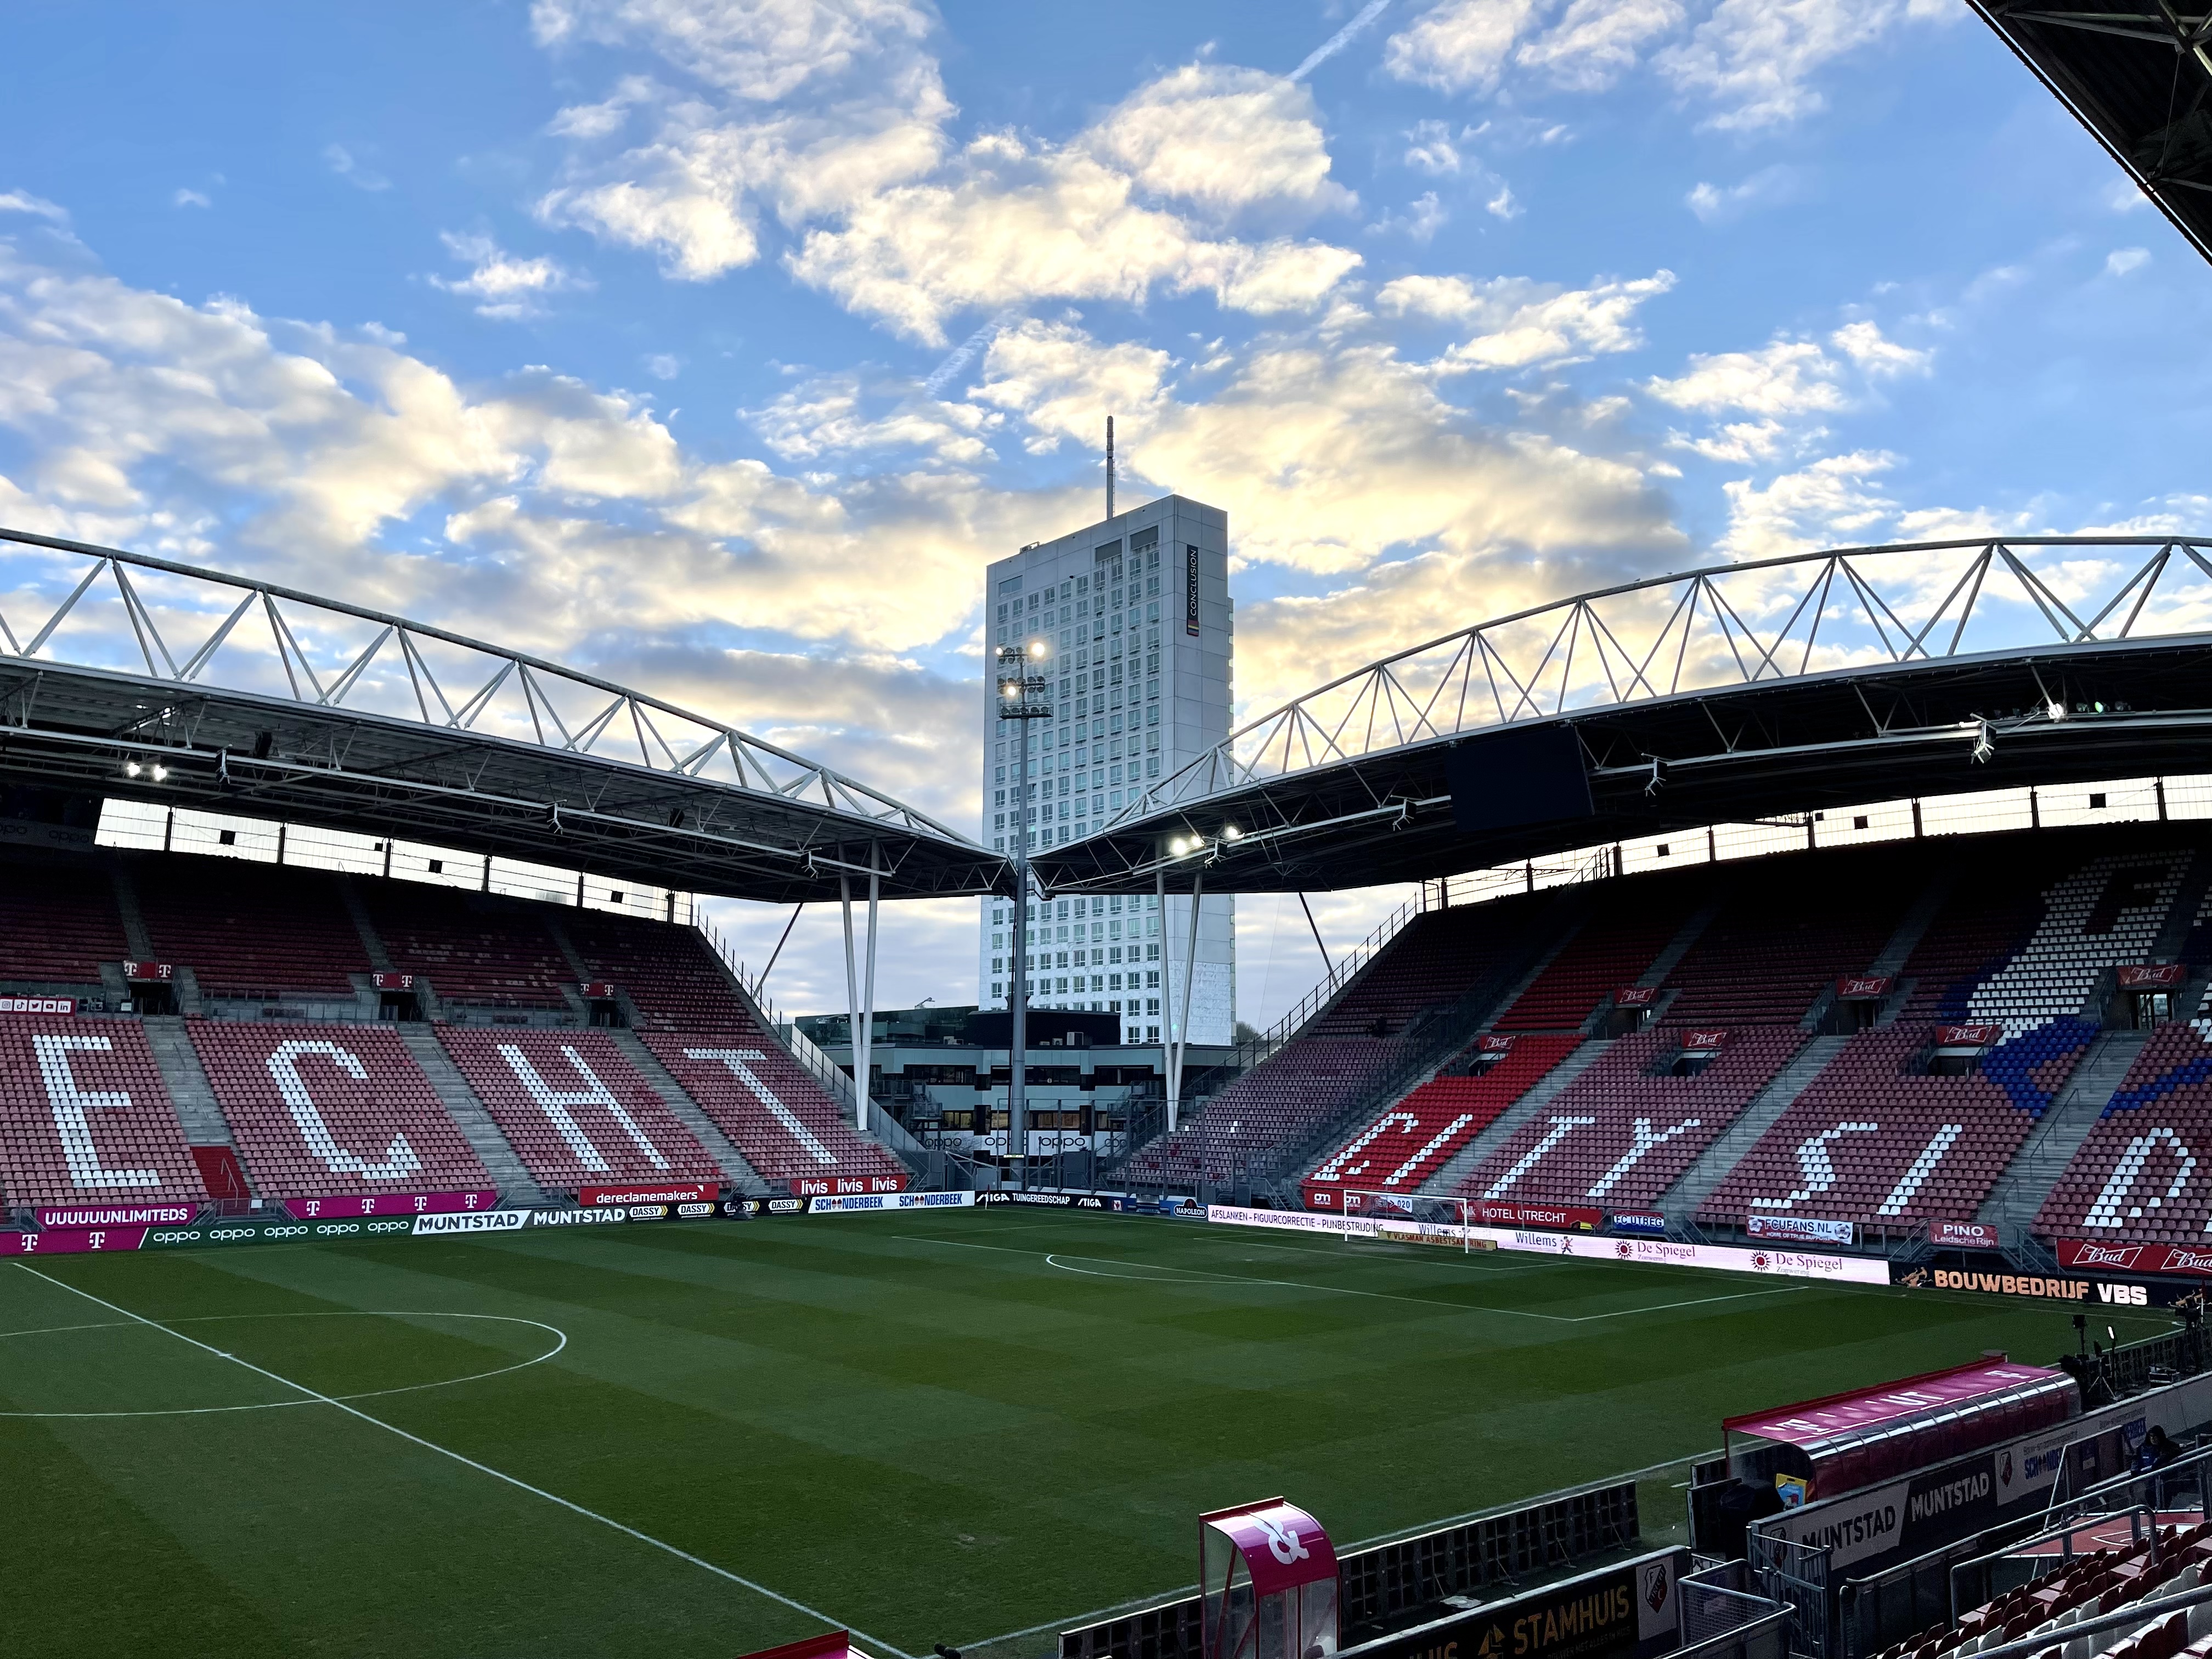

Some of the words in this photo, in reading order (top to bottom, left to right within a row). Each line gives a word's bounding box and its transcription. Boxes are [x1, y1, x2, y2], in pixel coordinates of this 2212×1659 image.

[925, 1138, 962, 1149] oppo
[1041, 1137, 1086, 1149] oppo
[802, 1180, 828, 1194] livis
[837, 1178, 863, 1193] livis
[872, 1177, 898, 1192] livis
[596, 1190, 698, 1204] dereclamemakers
[977, 1193, 1010, 1203] STIGA
[1012, 1193, 1070, 1205] TUINGEREEDSCHAP
[1077, 1198, 1102, 1207] STIGA
[1397, 1200, 1410, 1209] 020
[633, 1207, 659, 1216] DASSY
[681, 1204, 707, 1213] DASSY
[772, 1200, 795, 1209] DASSY
[1176, 1207, 1205, 1216] NAPOLEON
[1482, 1207, 1515, 1220] HOTEL
[1517, 1210, 1566, 1223] UTRECHT
[46, 1208, 188, 1225] UUUUUUNLIMITEDS
[419, 1214, 518, 1231] MUNTSTAD
[533, 1209, 625, 1226] MUNTSTAD
[1211, 1210, 1248, 1221] AFSLANKEN
[1254, 1213, 1316, 1227] FIGUURCORRECTIE
[1631, 1216, 1663, 1227] UTREG
[153, 1231, 201, 1243] oppo
[210, 1228, 255, 1240] oppo
[264, 1226, 308, 1238] oppo
[317, 1223, 360, 1235] oppo
[368, 1221, 409, 1233] oppo
[1765, 1219, 1832, 1233] FCUFANS.NL
[1943, 1224, 1984, 1237] PINO
[1393, 1233, 1424, 1242] VLASMAN
[1426, 1236, 1487, 1248] ASBESTSANRING
[1516, 1232, 1557, 1247] Willems
[1935, 1234, 1975, 1245] Leidsche
[1976, 1236, 1994, 1246] Rijn
[1638, 1242, 1652, 1253] De
[1656, 1243, 1696, 1259] Spiegel
[2085, 1247, 2125, 1262] Bud
[1776, 1253, 1793, 1265] De
[1797, 1255, 1843, 1272] Spiegel
[1934, 1270, 2089, 1300] BOUWBEDRIJF
[2097, 1283, 2147, 1306] VBS
[1911, 1472, 1989, 1521] MUNTSTAD
[1514, 1584, 1630, 1655] STAMHUIS
